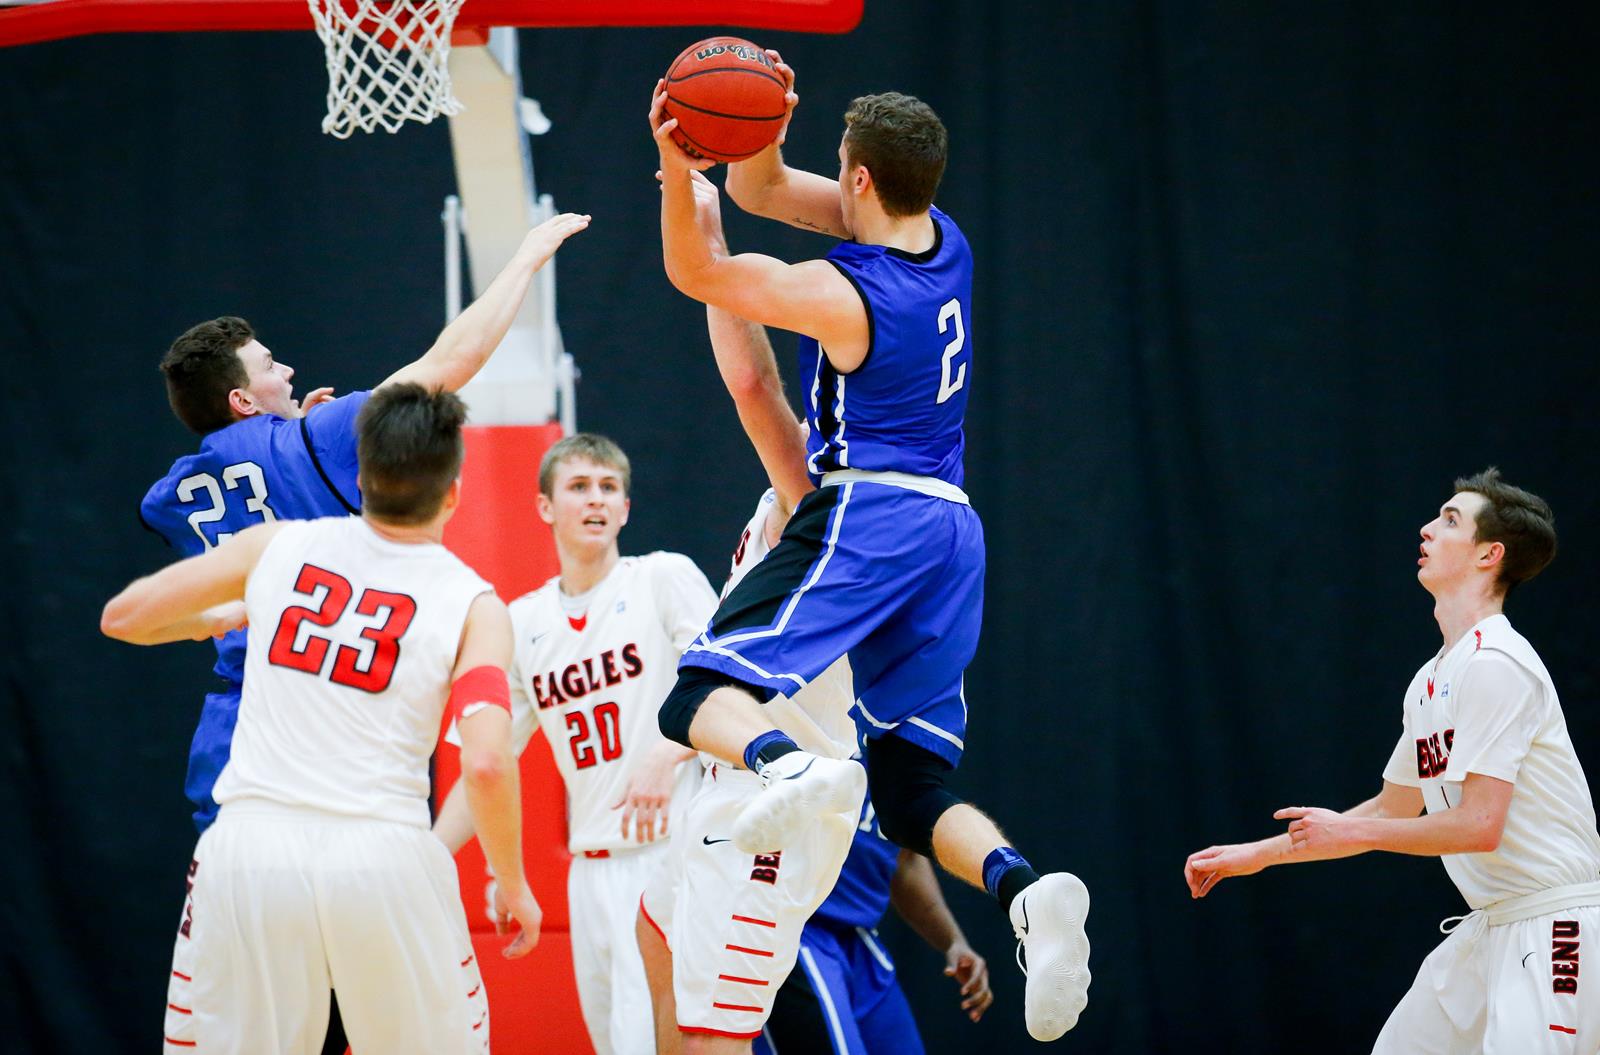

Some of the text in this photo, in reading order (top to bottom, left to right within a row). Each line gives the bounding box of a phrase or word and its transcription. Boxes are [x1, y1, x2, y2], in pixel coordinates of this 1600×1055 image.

[936, 297, 967, 405] 2
[268, 563, 417, 693] 23
[532, 643, 643, 711] EAGLES
[564, 701, 623, 771] 20
[1552, 920, 1580, 996] BENU
